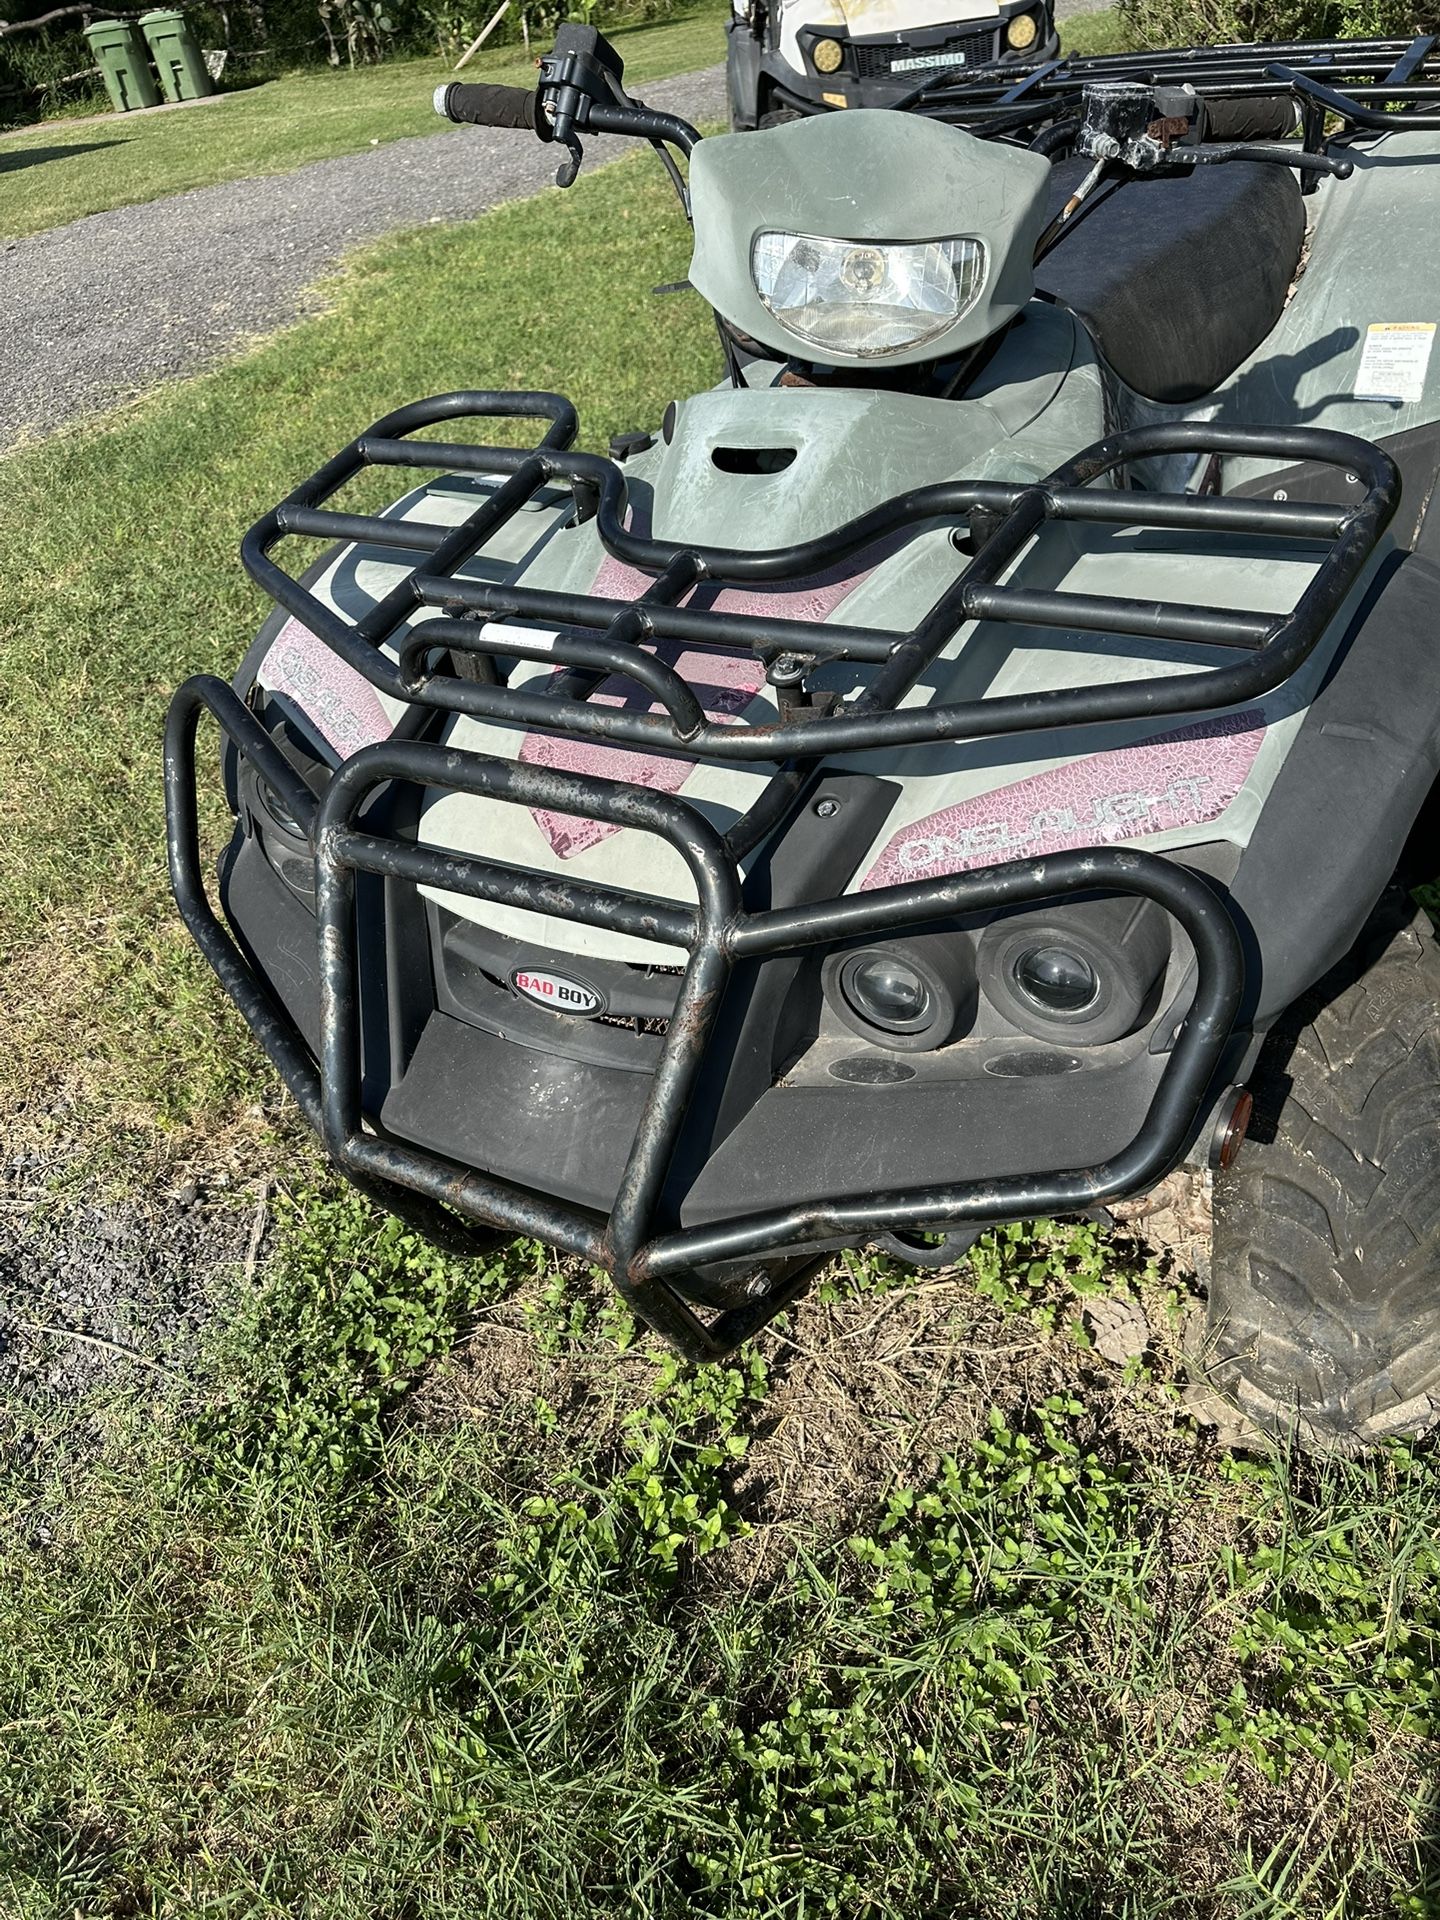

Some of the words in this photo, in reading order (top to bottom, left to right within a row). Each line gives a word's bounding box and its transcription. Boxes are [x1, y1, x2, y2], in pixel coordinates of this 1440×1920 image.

[891, 52, 965, 73] MASSIMO
[898, 775, 1212, 868] ONSLAUGHT
[516, 972, 554, 996] BAD
[558, 985, 596, 1007] BOY
